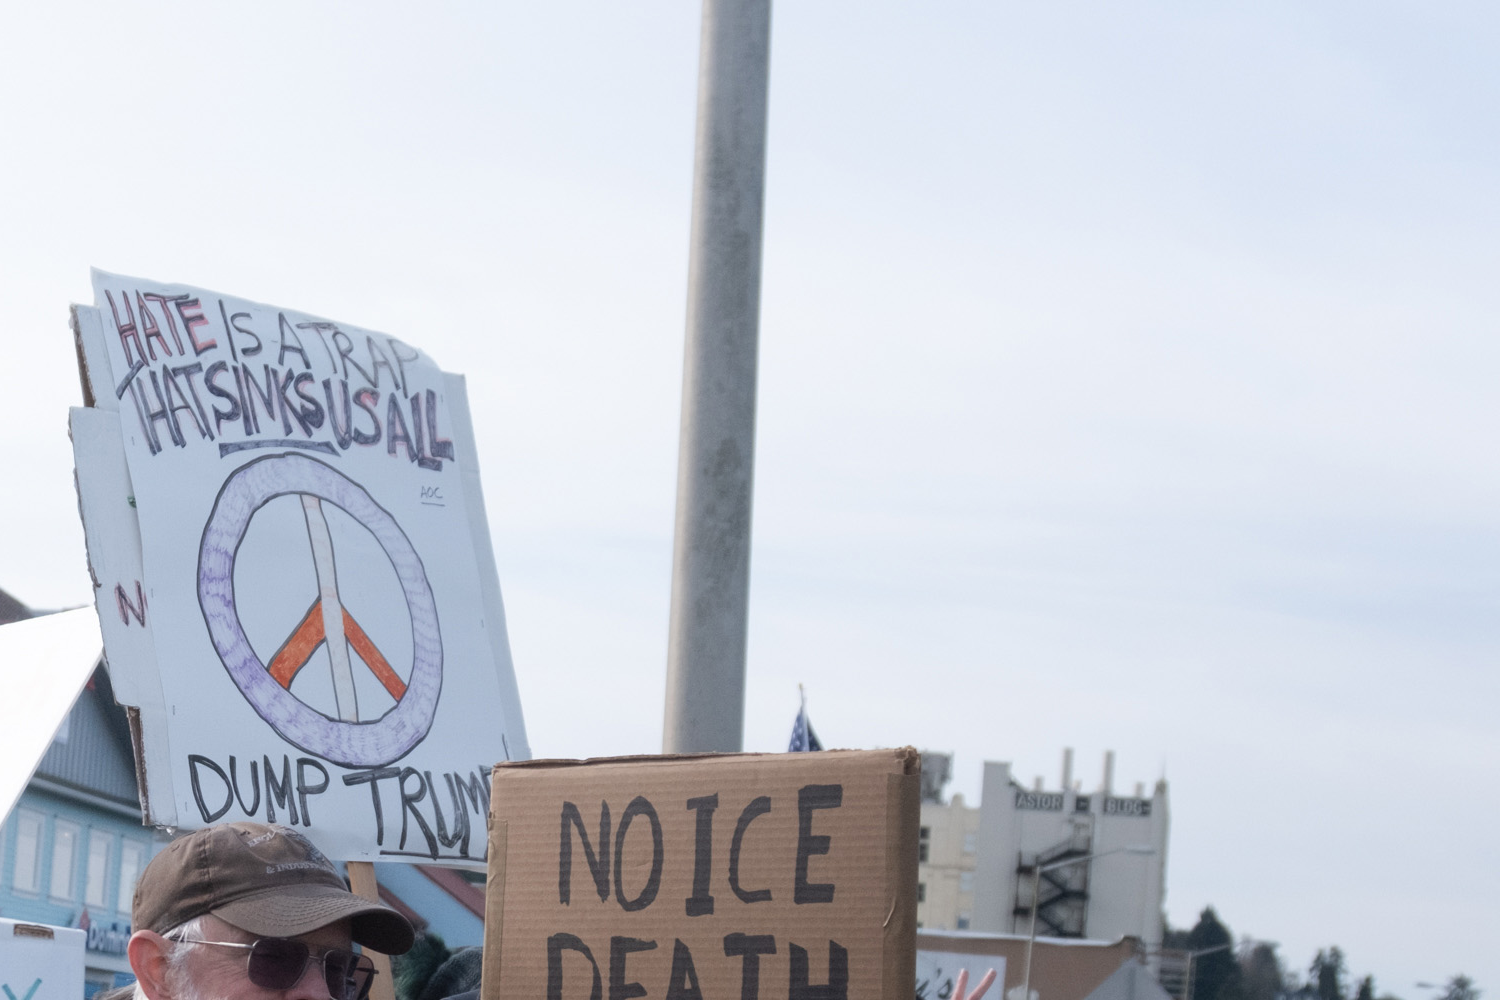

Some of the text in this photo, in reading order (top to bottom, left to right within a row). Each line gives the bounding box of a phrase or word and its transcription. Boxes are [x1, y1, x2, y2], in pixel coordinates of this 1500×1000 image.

[104, 289, 420, 398] HATE IS A TRAP
[116, 360, 455, 471] THAT SINKS US ALL
[420, 485, 444, 499] AOC
[188, 754, 331, 826] DUMP
[1017, 792, 1143, 815] ASTOR BLDG
[558, 784, 843, 916] NO ICE
